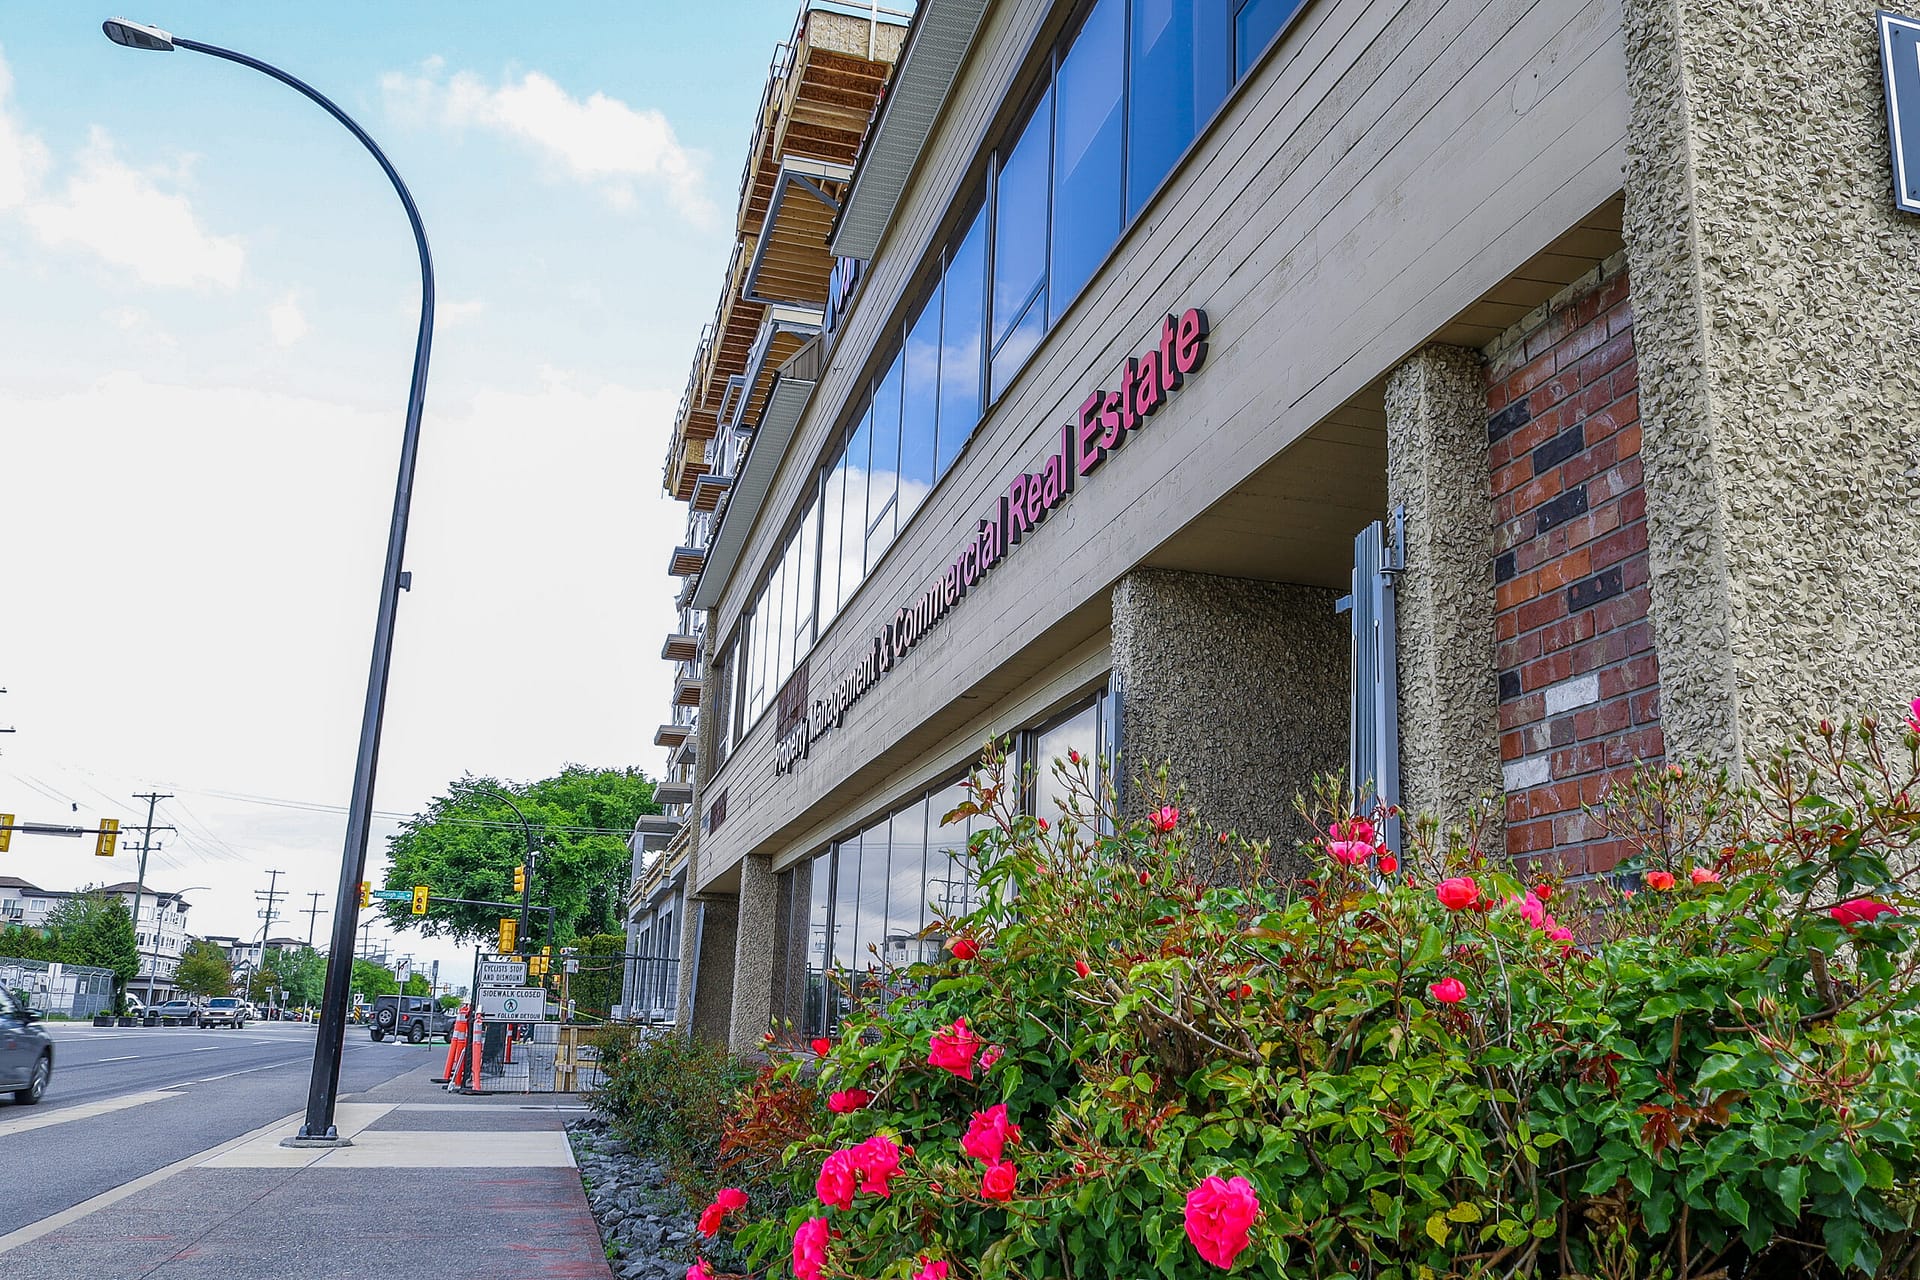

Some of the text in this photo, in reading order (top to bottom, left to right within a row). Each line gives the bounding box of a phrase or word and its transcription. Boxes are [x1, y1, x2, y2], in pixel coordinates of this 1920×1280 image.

[775, 308, 1209, 776] Property Management & Commercial Real Estate
[484, 965, 508, 973] CYCLISTS
[483, 990, 515, 998] SIDEWALK
